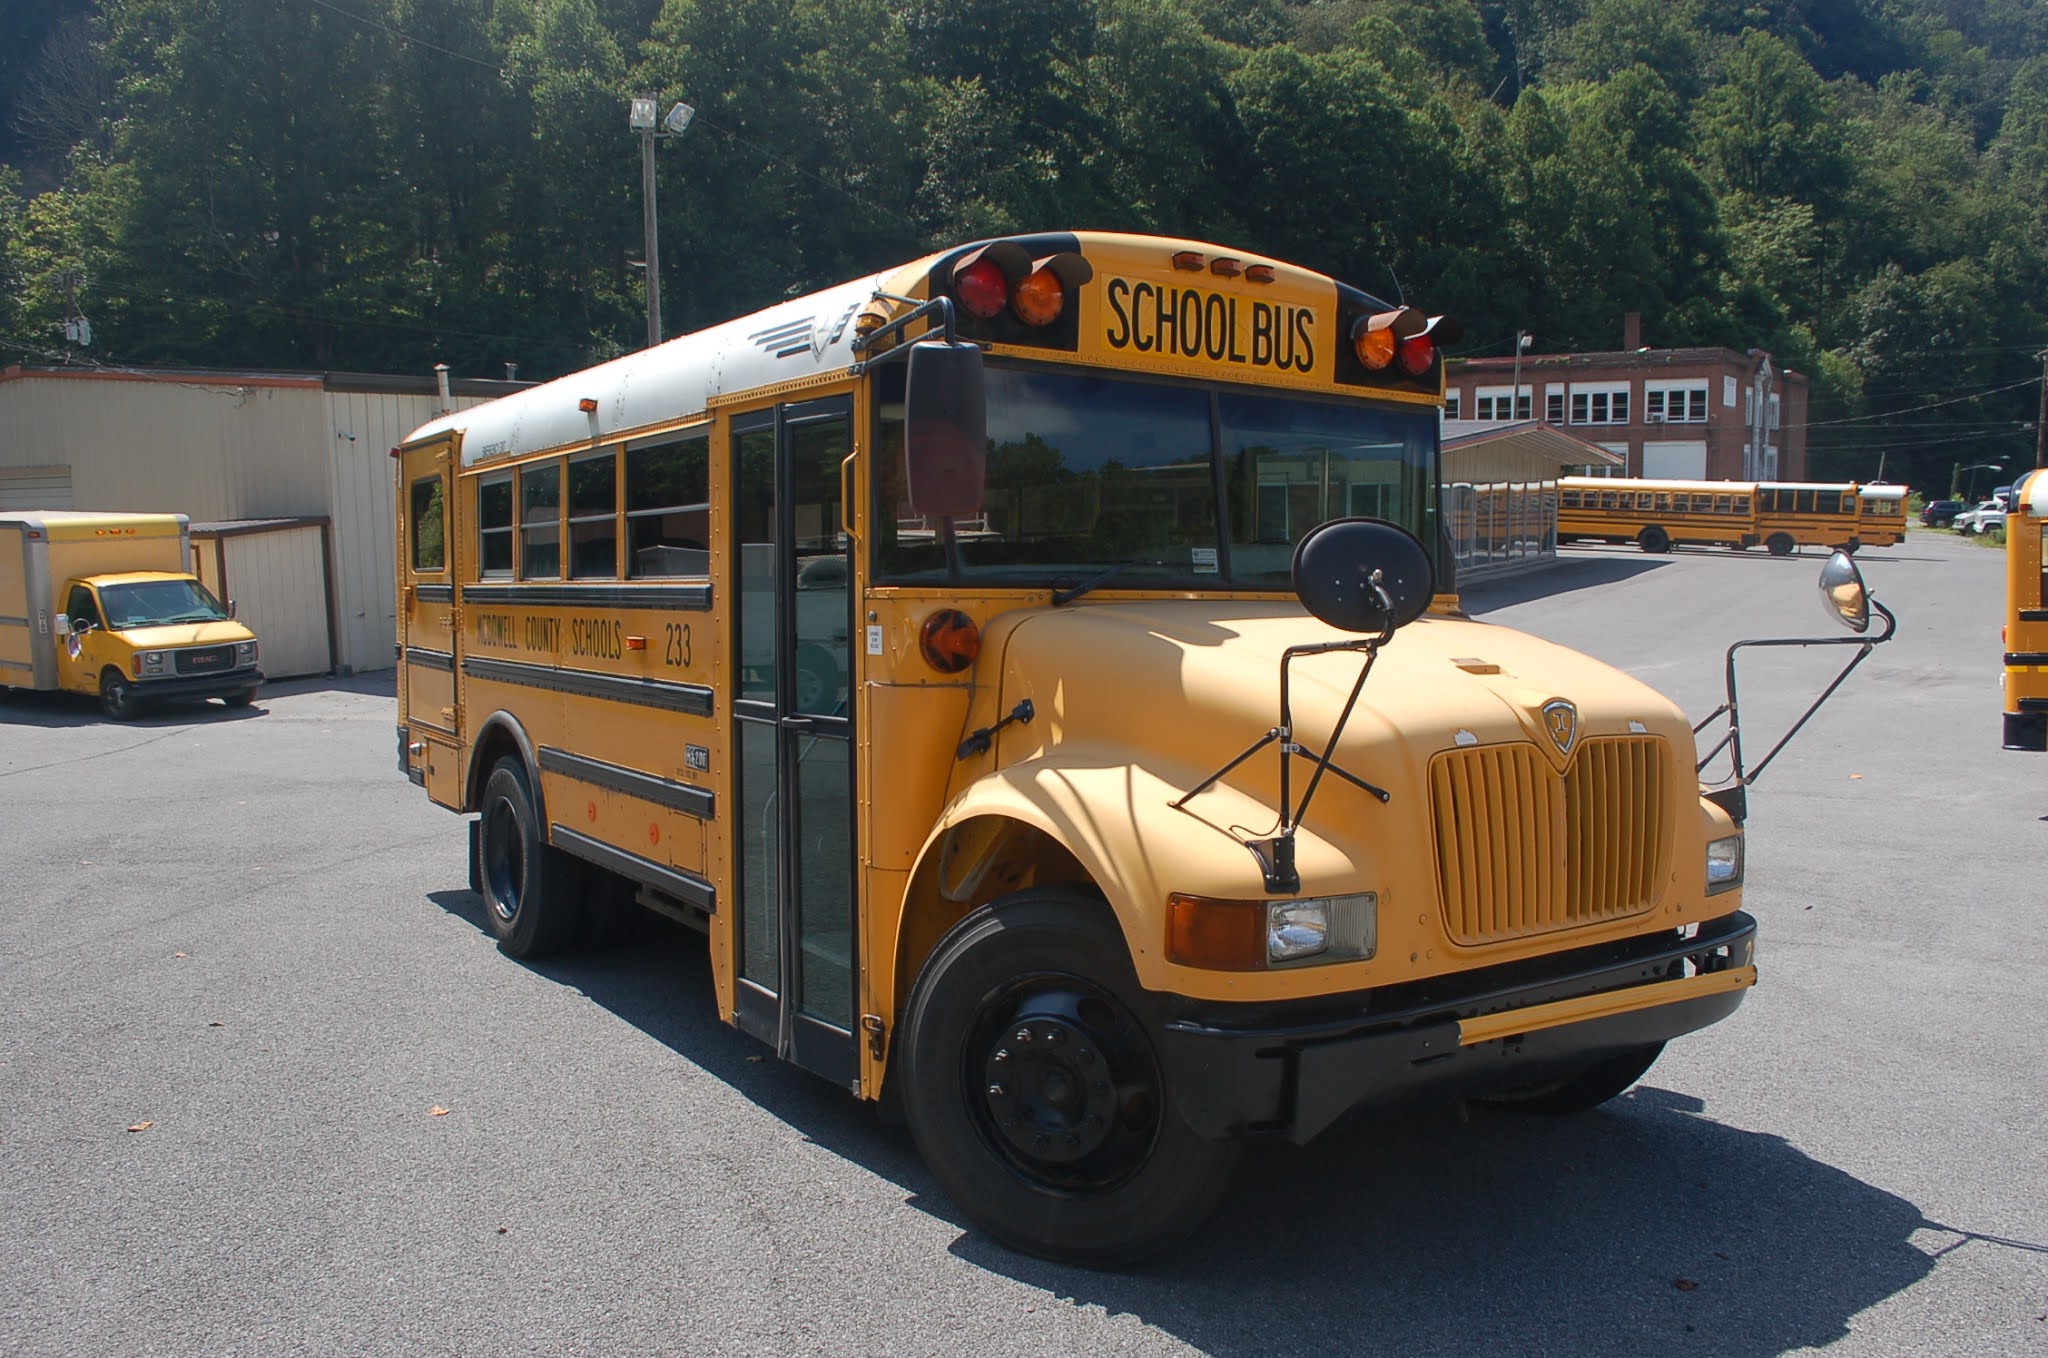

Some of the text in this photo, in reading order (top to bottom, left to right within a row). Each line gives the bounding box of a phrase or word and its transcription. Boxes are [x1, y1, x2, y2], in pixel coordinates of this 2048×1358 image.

[1107, 278, 1314, 373] SCHOOL BUS
[525, 616, 561, 653] COUNTY
[572, 618, 621, 660] SCHOOLS
[665, 622, 691, 668] 233
